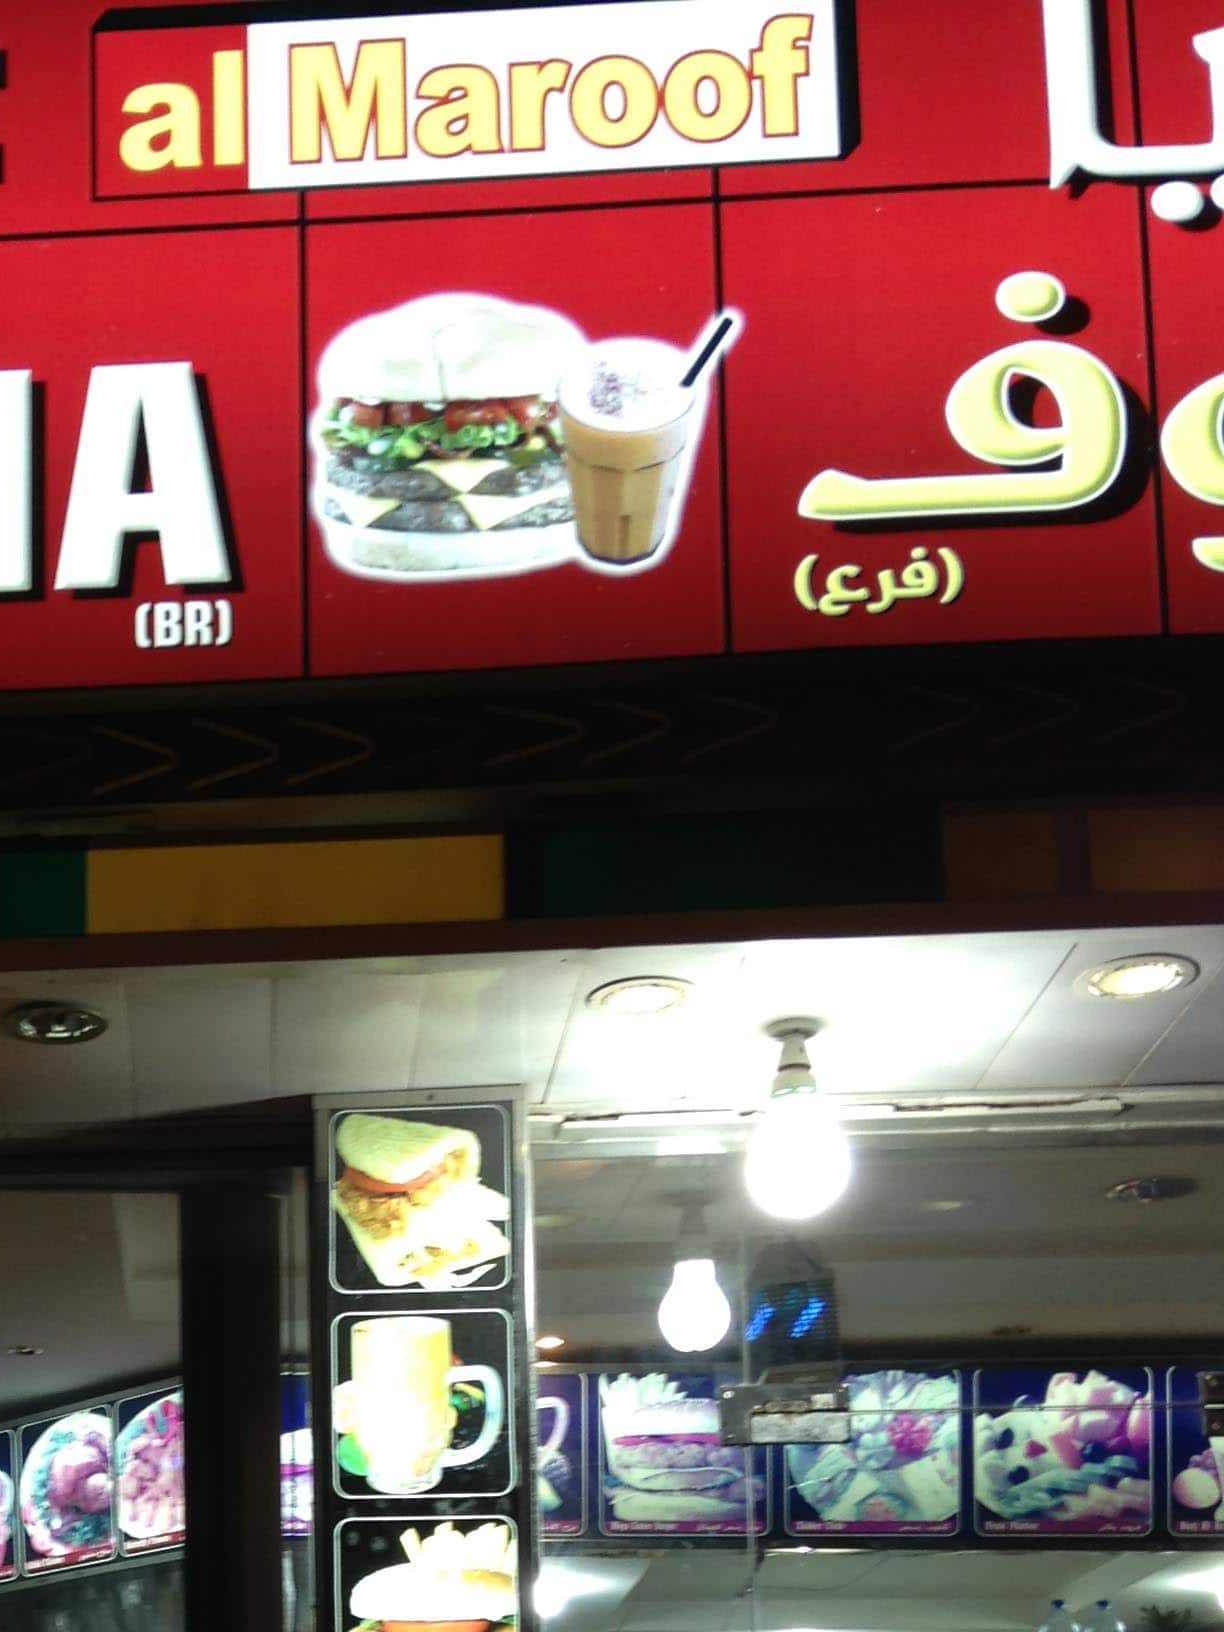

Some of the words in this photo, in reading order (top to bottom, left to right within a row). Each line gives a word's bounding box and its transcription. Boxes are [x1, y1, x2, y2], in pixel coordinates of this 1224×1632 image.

[119, 49, 245, 172] al
[287, 13, 815, 165] Maroof
[793, 546, 964, 616] (فرع)
[135, 599, 232, 648] (BR)
